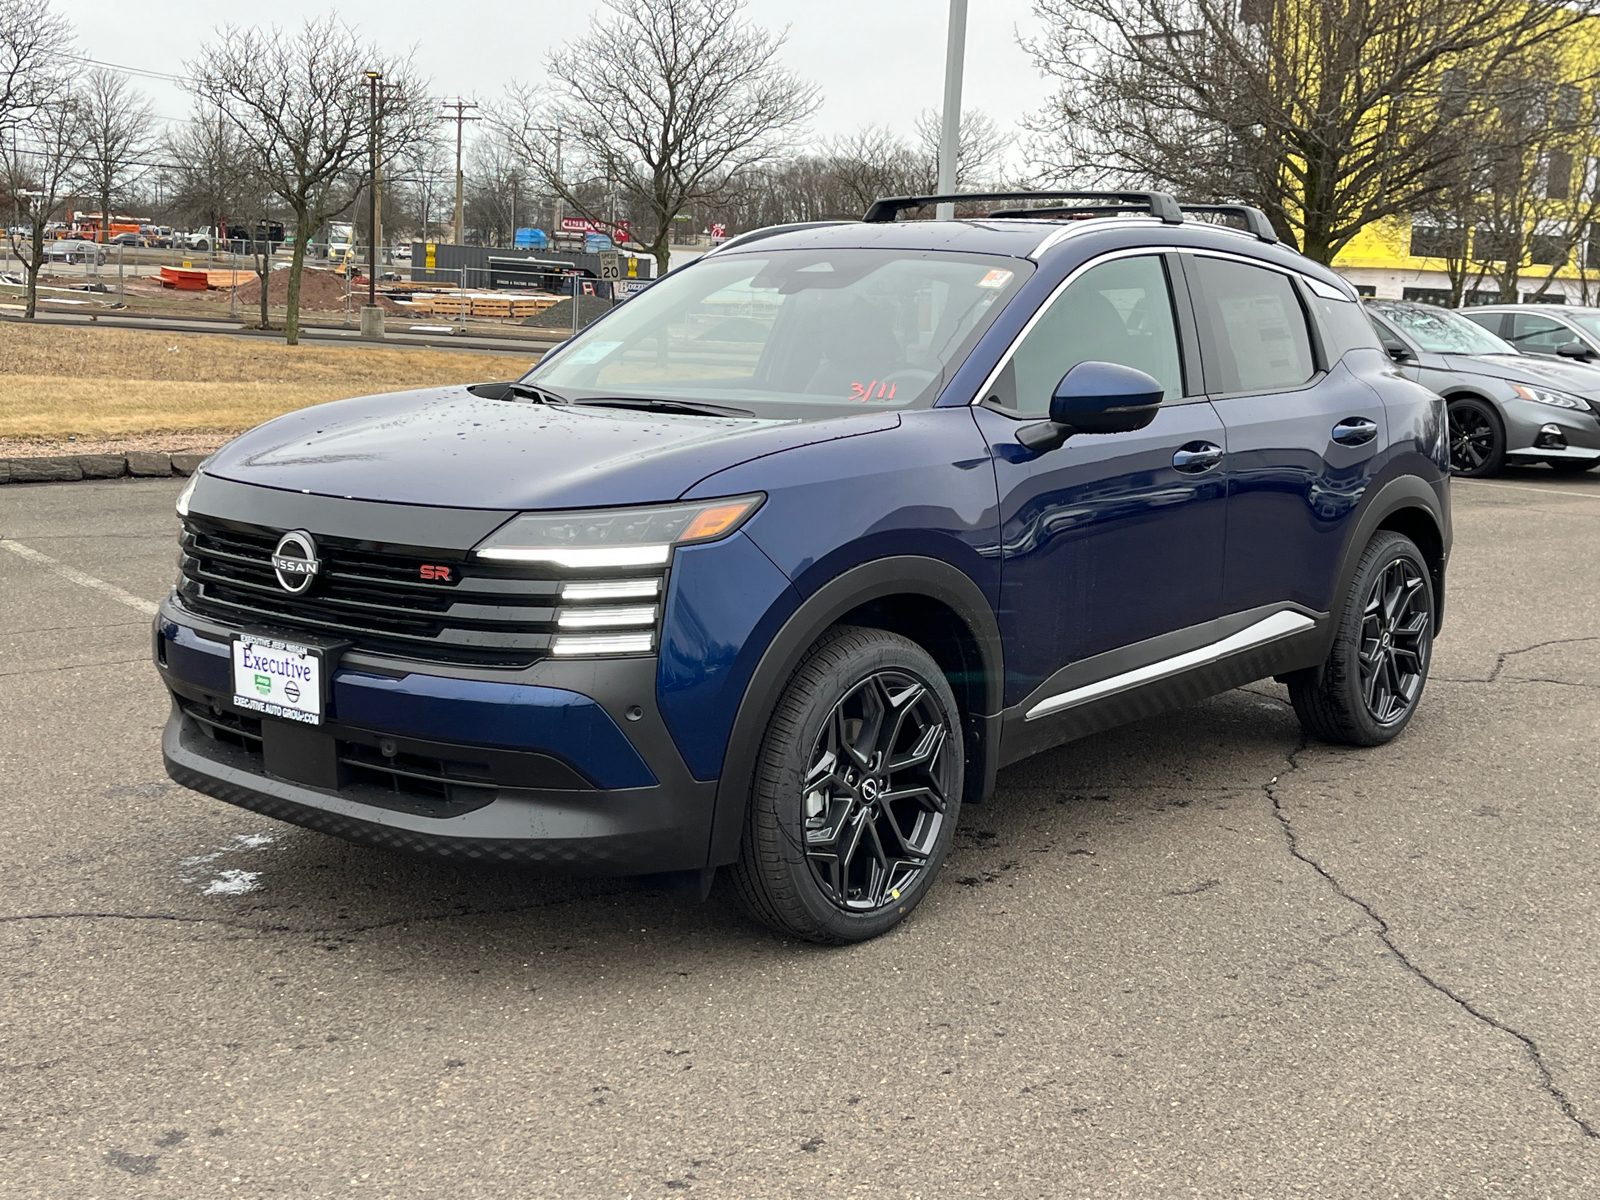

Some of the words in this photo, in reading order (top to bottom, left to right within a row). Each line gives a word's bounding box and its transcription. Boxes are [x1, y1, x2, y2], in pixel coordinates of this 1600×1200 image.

[562, 219, 607, 232] CINEMAR
[601, 252, 617, 260] SPEED
[602, 266, 619, 278] 20
[848, 378, 897, 403] 3/11
[271, 556, 316, 573] NISSAN
[420, 564, 450, 581] SR
[240, 634, 272, 648] EXECUTIVE
[271, 641, 286, 650] JEEP
[286, 643, 308, 655] NISSAN
[242, 646, 311, 682] Executive
[233, 695, 266, 712] EXECUTIVE
[265, 704, 282, 717] AUTO
[282, 707, 319, 725] GROUP.COM
